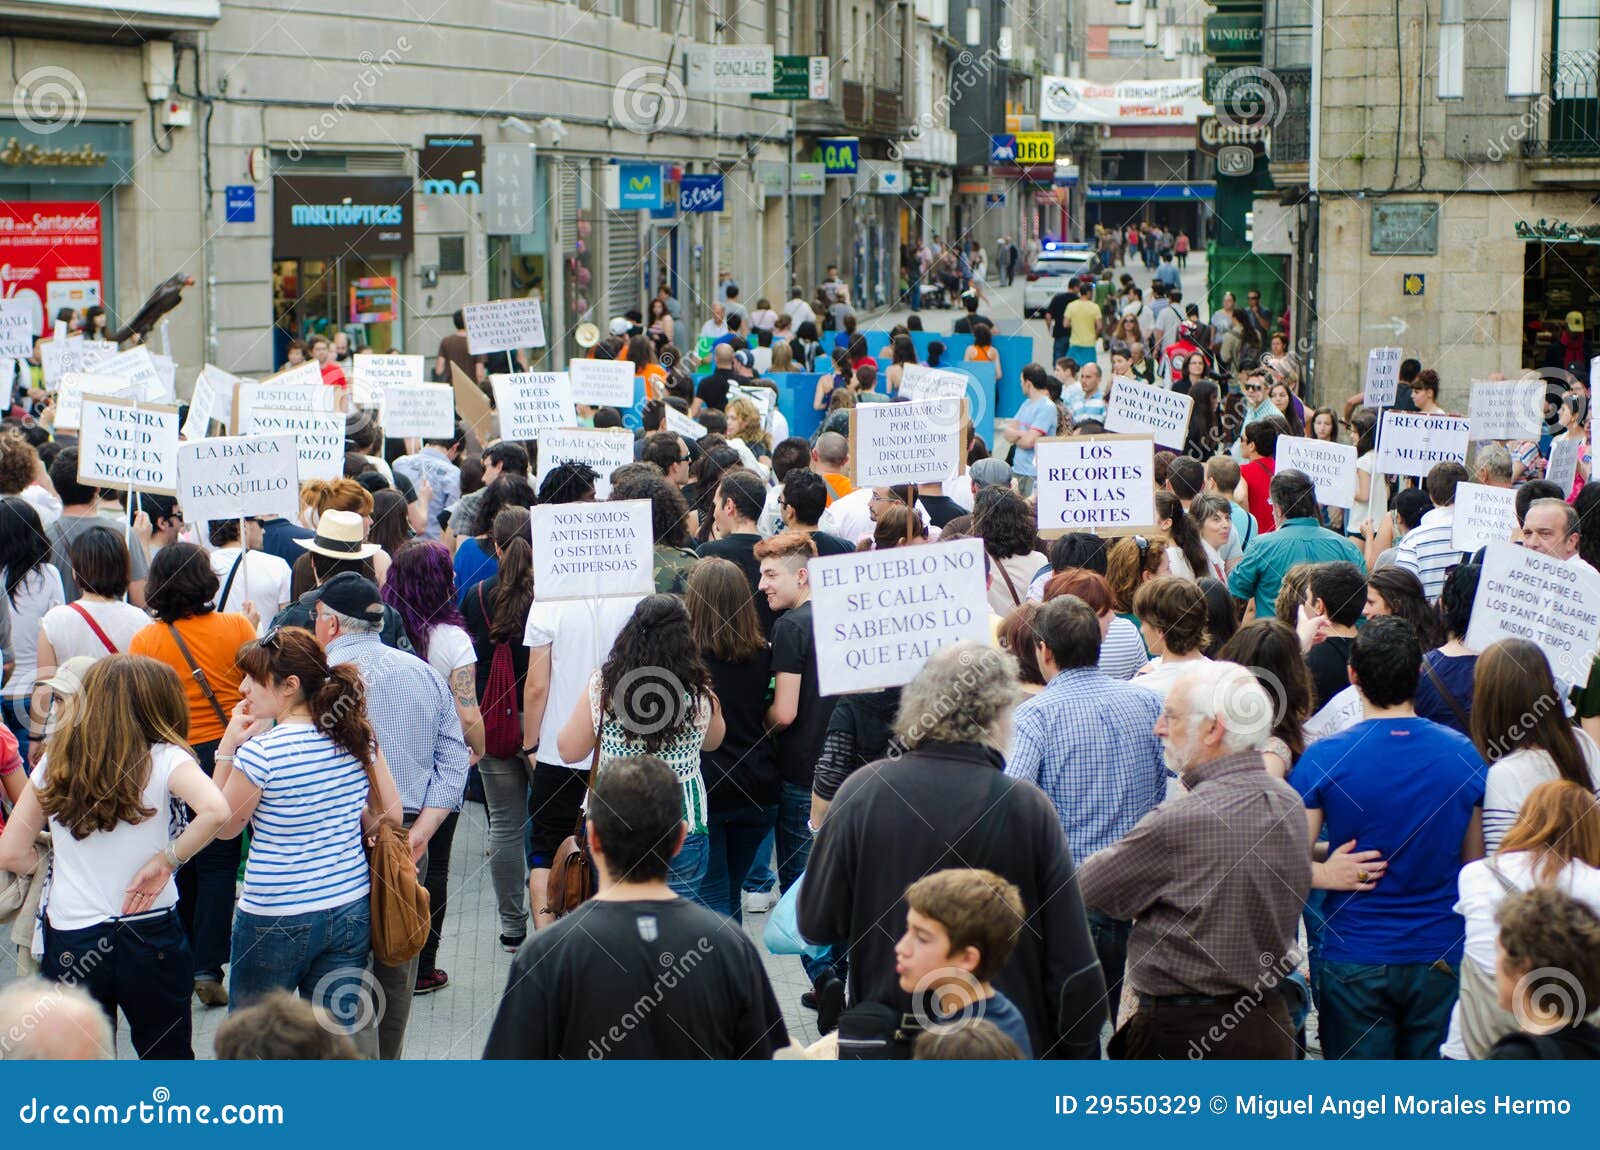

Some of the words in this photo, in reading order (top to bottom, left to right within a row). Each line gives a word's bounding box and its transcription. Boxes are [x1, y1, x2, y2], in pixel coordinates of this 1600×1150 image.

[519, 388, 550, 398] PECES
[1117, 383, 1139, 397] NON
[1164, 395, 1186, 409] PAN
[513, 401, 560, 411] MUERTOS
[874, 404, 943, 419] TRABAJAMOS
[1115, 394, 1144, 409] PARA
[1147, 403, 1184, 421] TANTO
[97, 406, 164, 428] NUESTRA
[254, 417, 282, 428] NON
[1118, 408, 1177, 431] CHOURIZO
[889, 421, 910, 432] POR
[913, 420, 928, 431] UN
[104, 426, 152, 444] SALUD
[872, 435, 912, 447] MUNDO
[914, 432, 948, 445] MEJOR
[97, 444, 118, 458] NO
[141, 450, 162, 464] UN
[195, 446, 218, 460] LA
[222, 440, 280, 458] BANCA
[879, 447, 936, 461] DISCULPEN
[1080, 445, 1112, 460] LOS
[1303, 448, 1346, 465] VERDAD
[1396, 448, 1464, 462] MUERTOS
[95, 462, 163, 483] NEGOCIO
[229, 462, 249, 476] AL
[868, 464, 888, 477] LAS
[890, 460, 948, 474] MOLESTIAS
[1048, 465, 1142, 481] RECORTES
[1312, 464, 1341, 476] HACE
[192, 477, 289, 498] BANQUILLO
[1065, 488, 1088, 502] EN
[1092, 487, 1126, 501] LAS
[554, 513, 583, 526] NON
[585, 511, 631, 524] SOMOS
[1060, 507, 1131, 524] CORTES
[550, 527, 637, 542] ANTISISTEMA
[554, 547, 564, 558] O
[567, 544, 622, 557] SISTEMA
[624, 540, 633, 554] É
[550, 559, 638, 575] ANTIPERSOAS
[822, 568, 848, 588] EL
[854, 555, 938, 583] PUEBLO
[943, 551, 975, 572] NO
[1525, 556, 1541, 571] NO
[1542, 564, 1578, 583] PUEDO
[1508, 569, 1570, 599] APRETARME
[1572, 591, 1584, 604] EL
[847, 592, 873, 613] SE
[1486, 597, 1509, 614] LOS
[1509, 604, 1577, 637] PANTALONES
[1577, 628, 1590, 641] AL
[1552, 600, 1598, 626] BAJARME
[834, 612, 937, 642] SABEMOS
[943, 606, 972, 628] LO
[1499, 619, 1534, 640] MISMO
[845, 645, 890, 670] QUE
